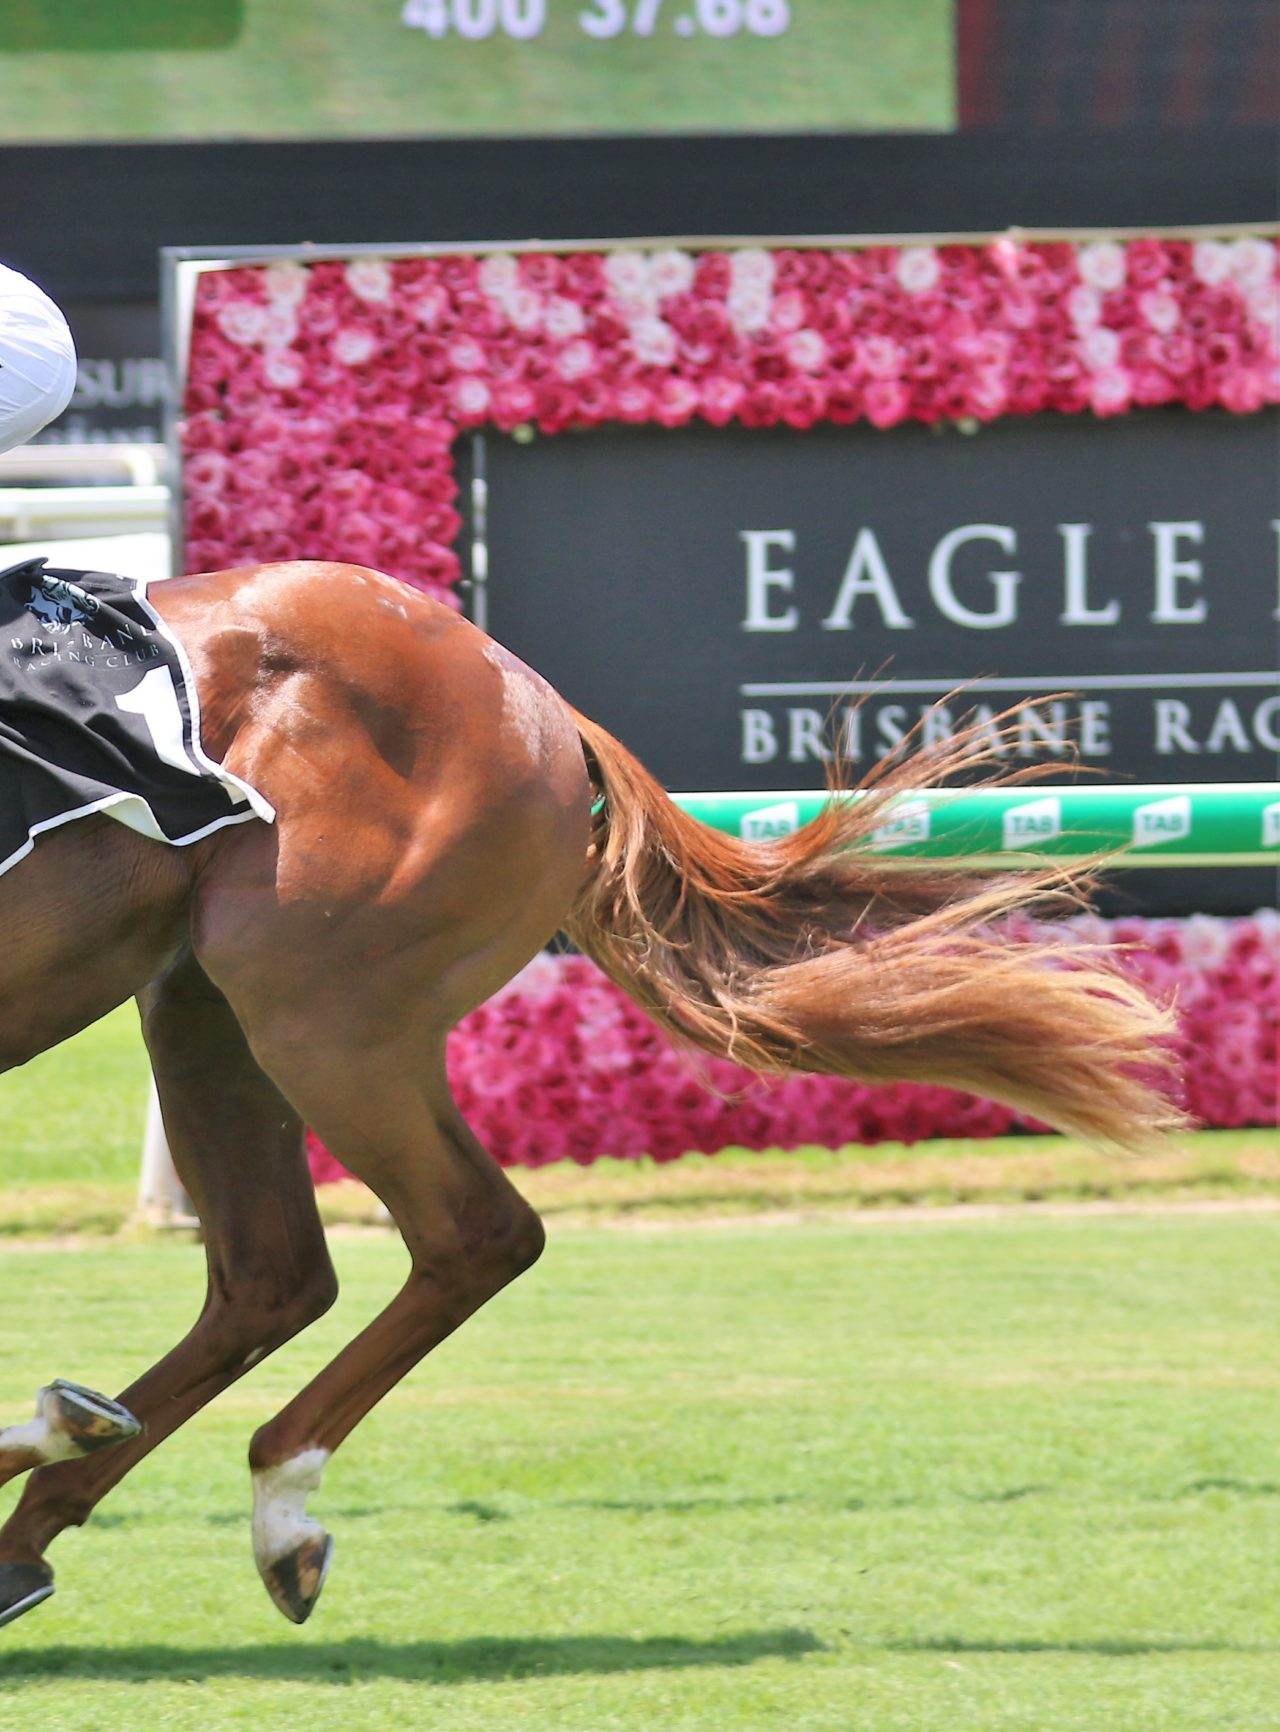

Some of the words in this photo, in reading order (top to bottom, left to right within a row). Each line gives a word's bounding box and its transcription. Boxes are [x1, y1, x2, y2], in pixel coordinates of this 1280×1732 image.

[740, 520, 1208, 632] EAGLE
[106, 643, 160, 669] CLUB
[741, 699, 1112, 764] BRISBANE
[1011, 814, 1054, 834] TAB
[1141, 813, 1184, 833] TAB
